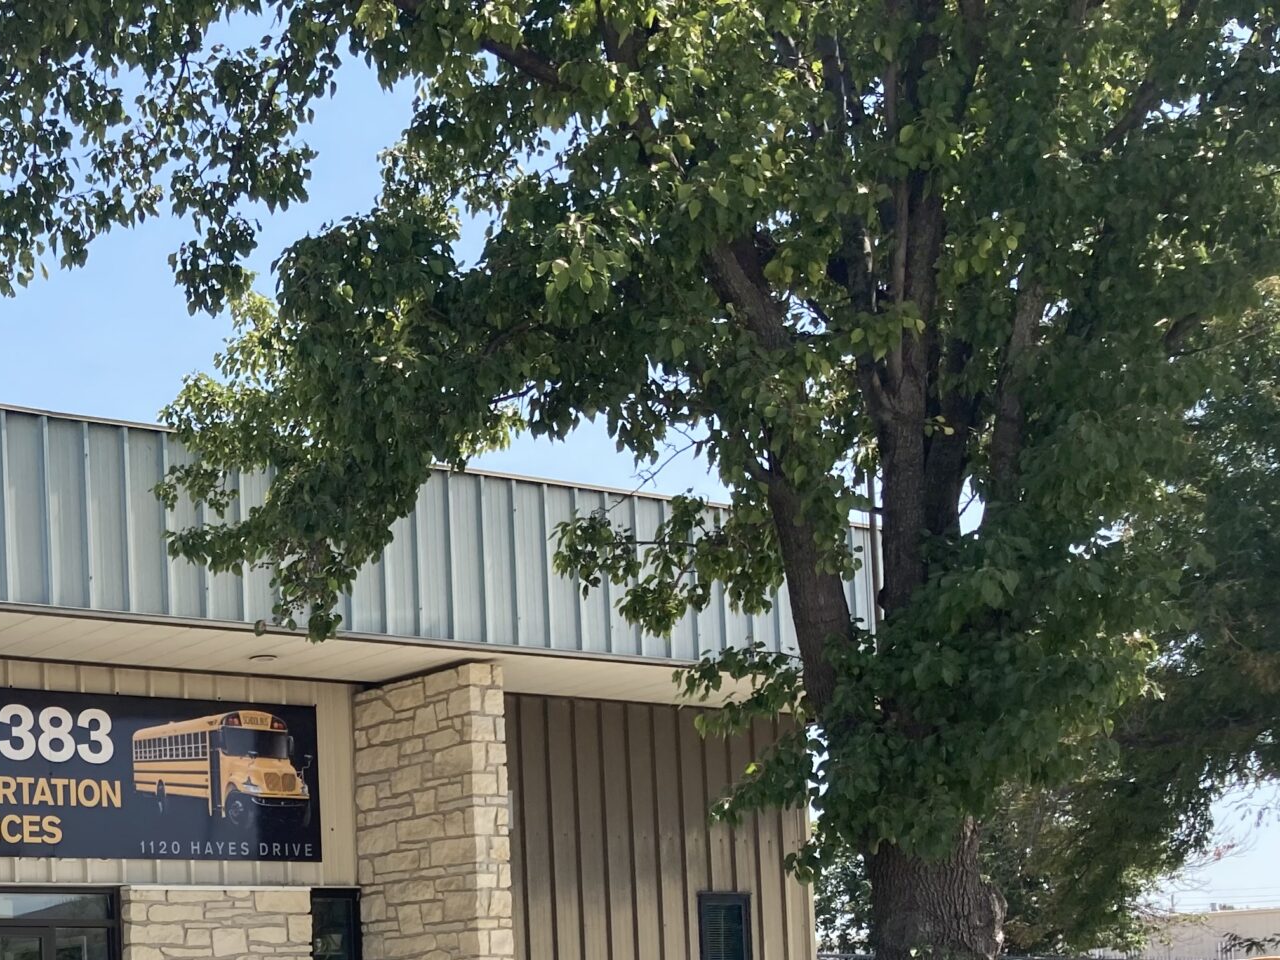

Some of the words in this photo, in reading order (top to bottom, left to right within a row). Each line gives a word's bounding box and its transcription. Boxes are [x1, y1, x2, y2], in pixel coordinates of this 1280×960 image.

[140, 840, 181, 854] 1120
[191, 841, 249, 856] HAYES
[259, 843, 313, 857] DRIVE
